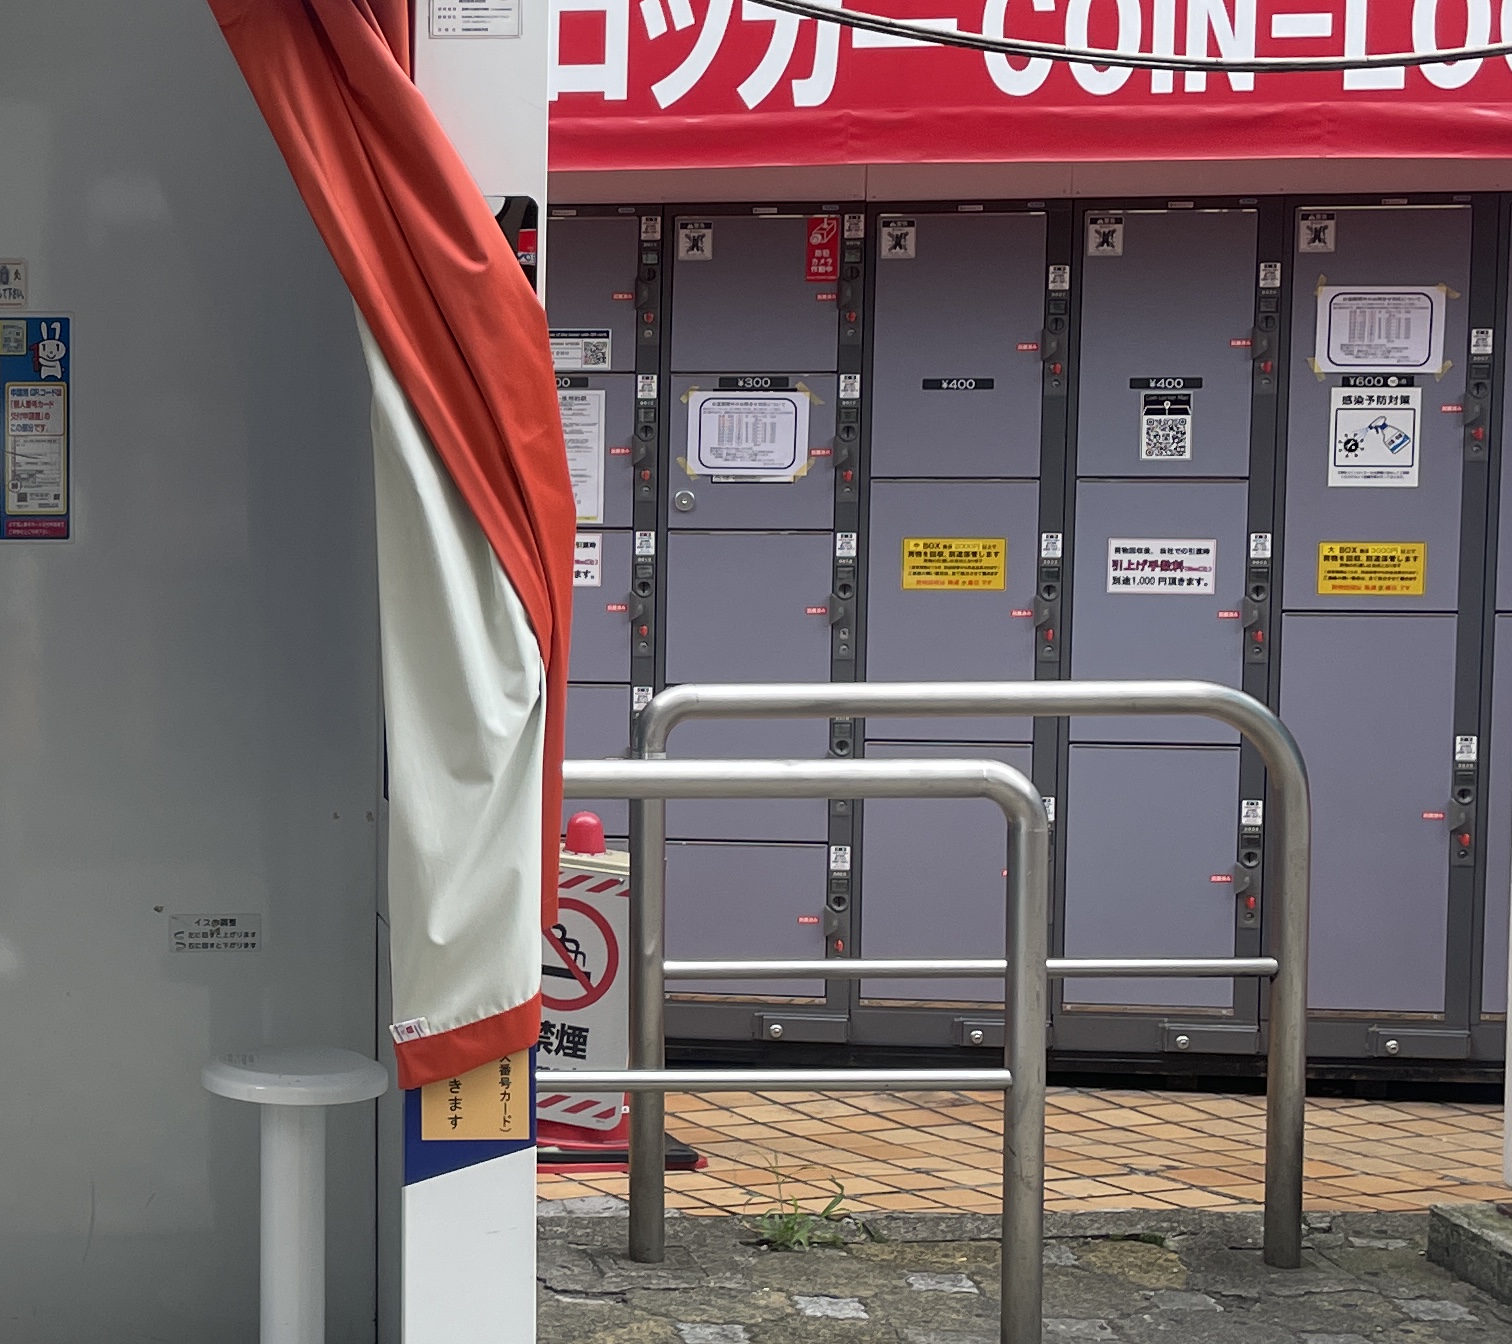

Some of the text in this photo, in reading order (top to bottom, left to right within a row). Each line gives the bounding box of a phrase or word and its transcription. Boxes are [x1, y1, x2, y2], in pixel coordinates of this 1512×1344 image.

[737, 377, 771, 388] ¥300
[940, 378, 976, 389] ¥400
[1149, 378, 1185, 388] ¥400
[1348, 376, 1384, 387] ¥600
[1341, 394, 1411, 406] 感染予防対策
[194, 918, 237, 927] イス調整
